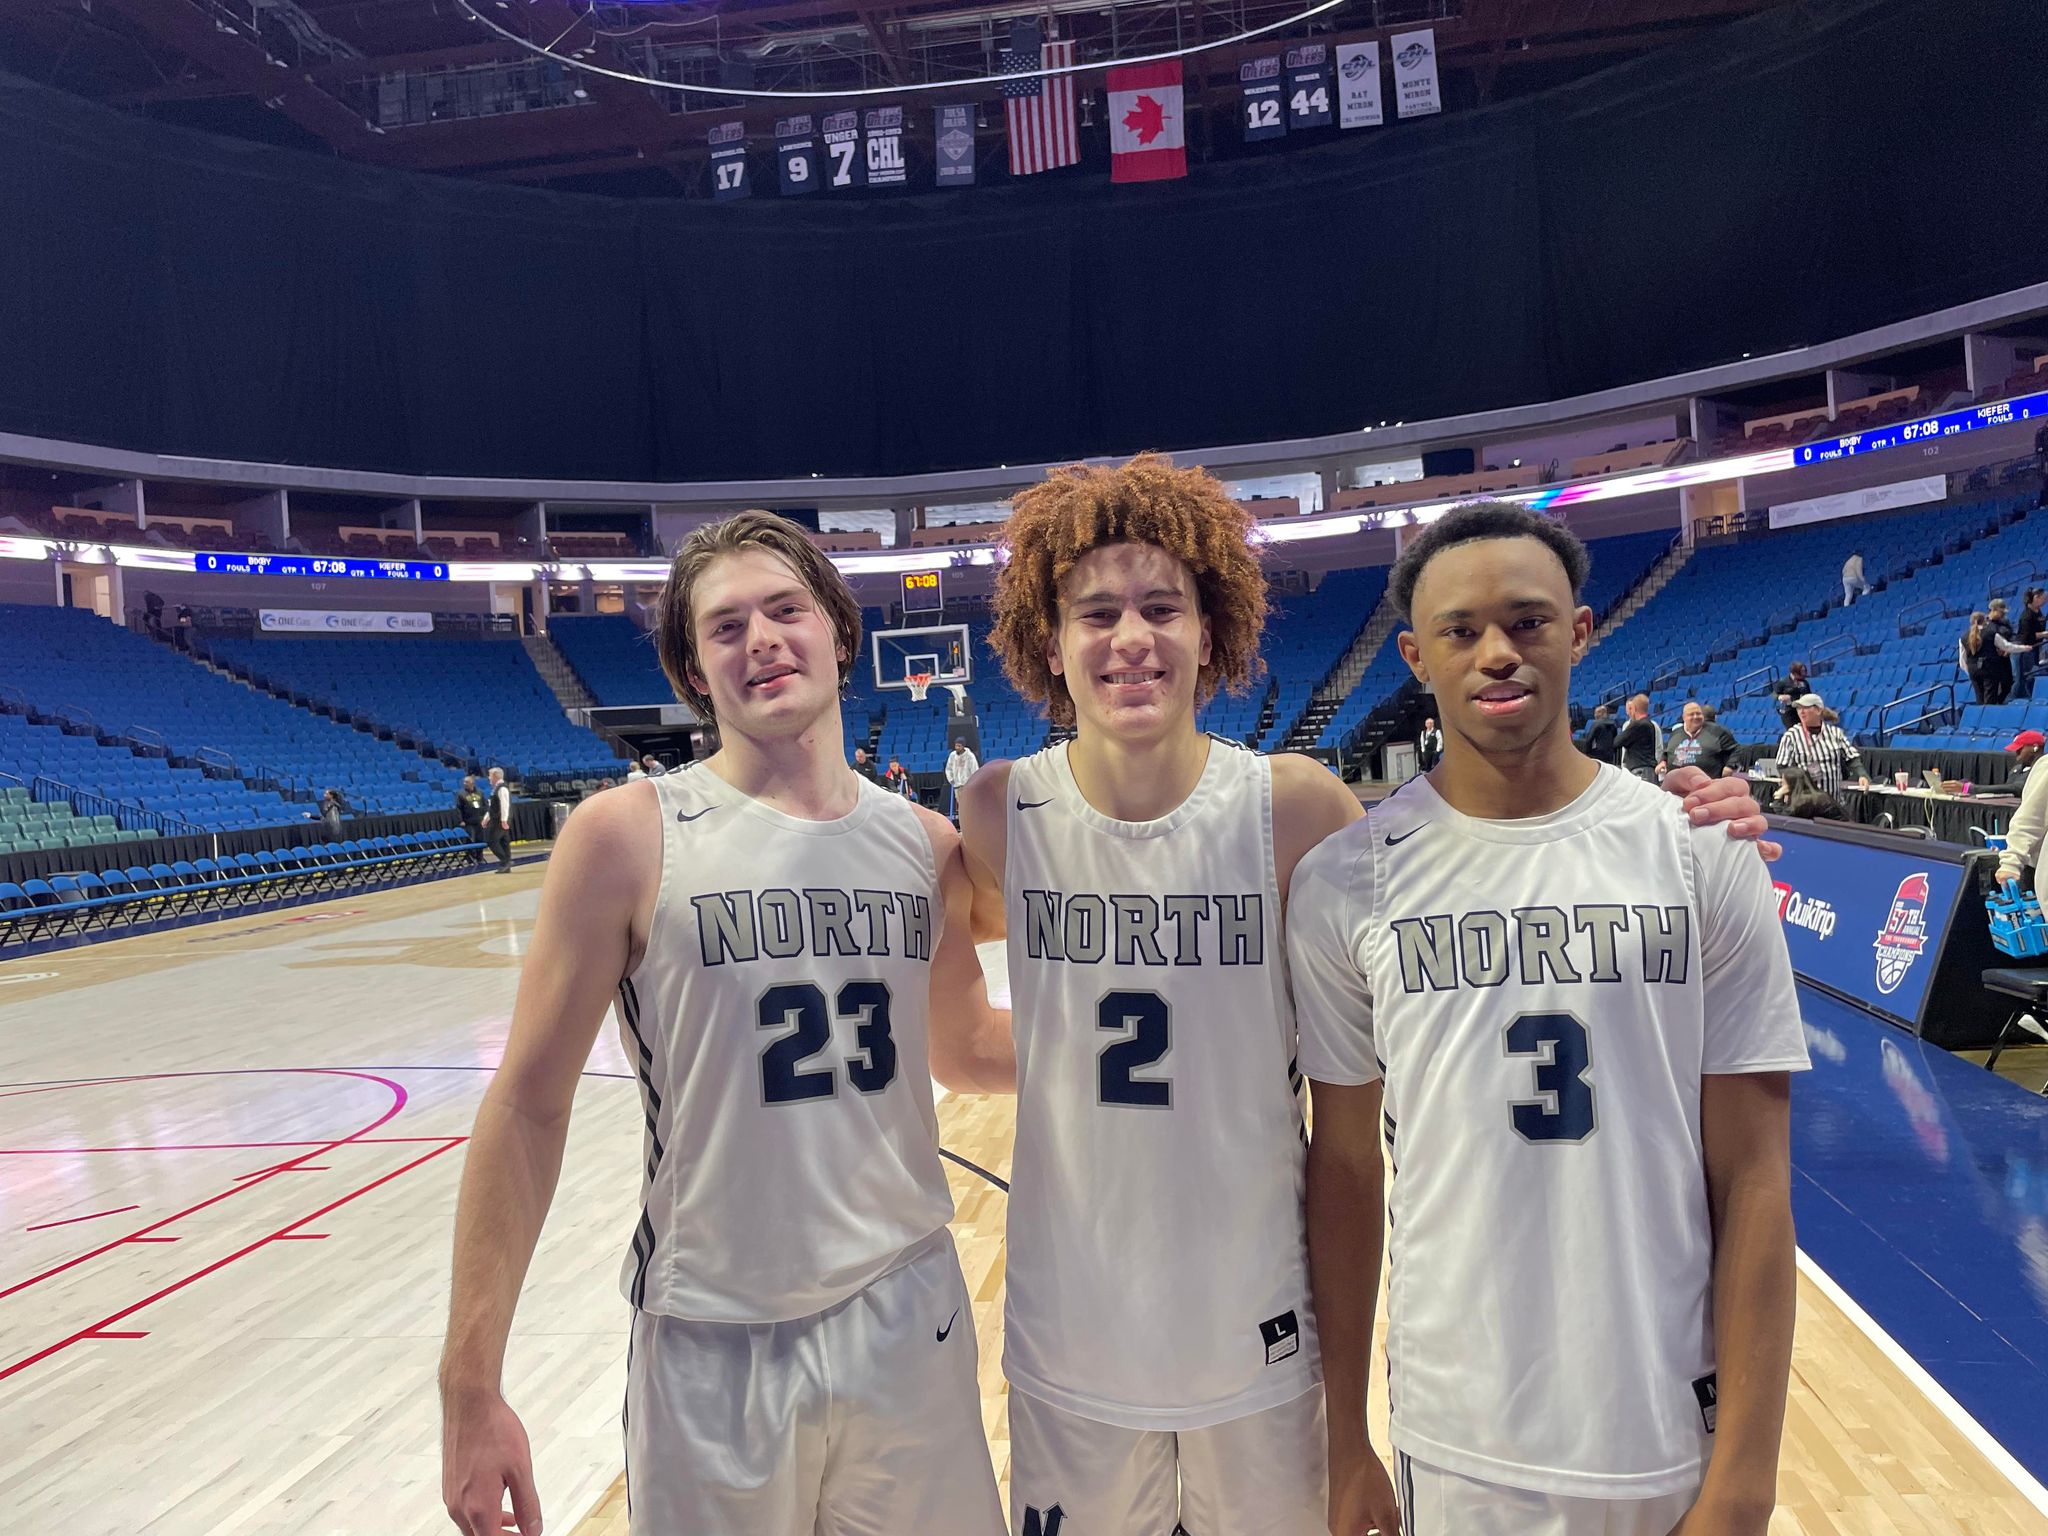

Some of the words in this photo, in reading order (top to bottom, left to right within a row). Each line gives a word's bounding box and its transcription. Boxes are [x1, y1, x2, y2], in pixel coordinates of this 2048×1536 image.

[1402, 78, 1431, 89] MONTE
[1351, 90, 1368, 99] RAY
[1404, 89, 1431, 99] MIRON
[1291, 87, 1329, 116] 44
[1347, 101, 1373, 110] MIRON
[1247, 99, 1281, 129] 12
[824, 129, 858, 144] UNGER
[867, 136, 905, 170] CHL
[788, 156, 809, 182] 9
[829, 141, 855, 186] 7
[716, 162, 744, 190] 17
[1978, 403, 2010, 418] KIEFER
[1988, 413, 2013, 424] FOULS
[2023, 409, 2029, 419] 0
[1903, 421, 1939, 440] 67:08
[1944, 424, 1960, 435] QTR
[1967, 421, 1971, 430] 1
[1839, 436, 1861, 448] BIXBY
[1872, 440, 1887, 449] QTR
[1891, 437, 1896, 446] 1
[1804, 448, 1812, 461] 0
[1820, 449, 1842, 459] FOULS
[1849, 446, 1854, 455] 0
[1923, 447, 1939, 456] 102
[208, 556, 217, 569] 0
[248, 556, 271, 566] BIXBY
[313, 560, 346, 574] 67:08
[379, 562, 406, 571] KIEFER
[226, 564, 250, 573] FOULS
[258, 565, 264, 574] 0
[282, 566, 297, 574] QTR
[302, 567, 306, 575] 1
[351, 569, 365, 577] QTR
[370, 569, 375, 577] 1
[387, 570, 408, 578] FOULS
[415, 571, 420, 579] 0
[434, 565, 442, 578] 0
[311, 583, 326, 591] 107
[906, 574, 937, 589] 67:08
[278, 617, 295, 626] ONE
[341, 618, 357, 627] ONE
[401, 618, 416, 628] ONE
[1786, 891, 1836, 941] QuikTrip
[1888, 909, 1908, 933] 57
[1907, 909, 1920, 925] TH
[691, 887, 931, 967] NORTH
[1022, 889, 1264, 967] NORTH
[1390, 904, 1691, 994] NORTH
[1879, 945, 1915, 962] CHAMPIONS
[755, 978, 899, 1108] 23
[1096, 988, 1174, 1110] 2
[1501, 1009, 1600, 1146] 3
[1274, 1322, 1287, 1337] L
